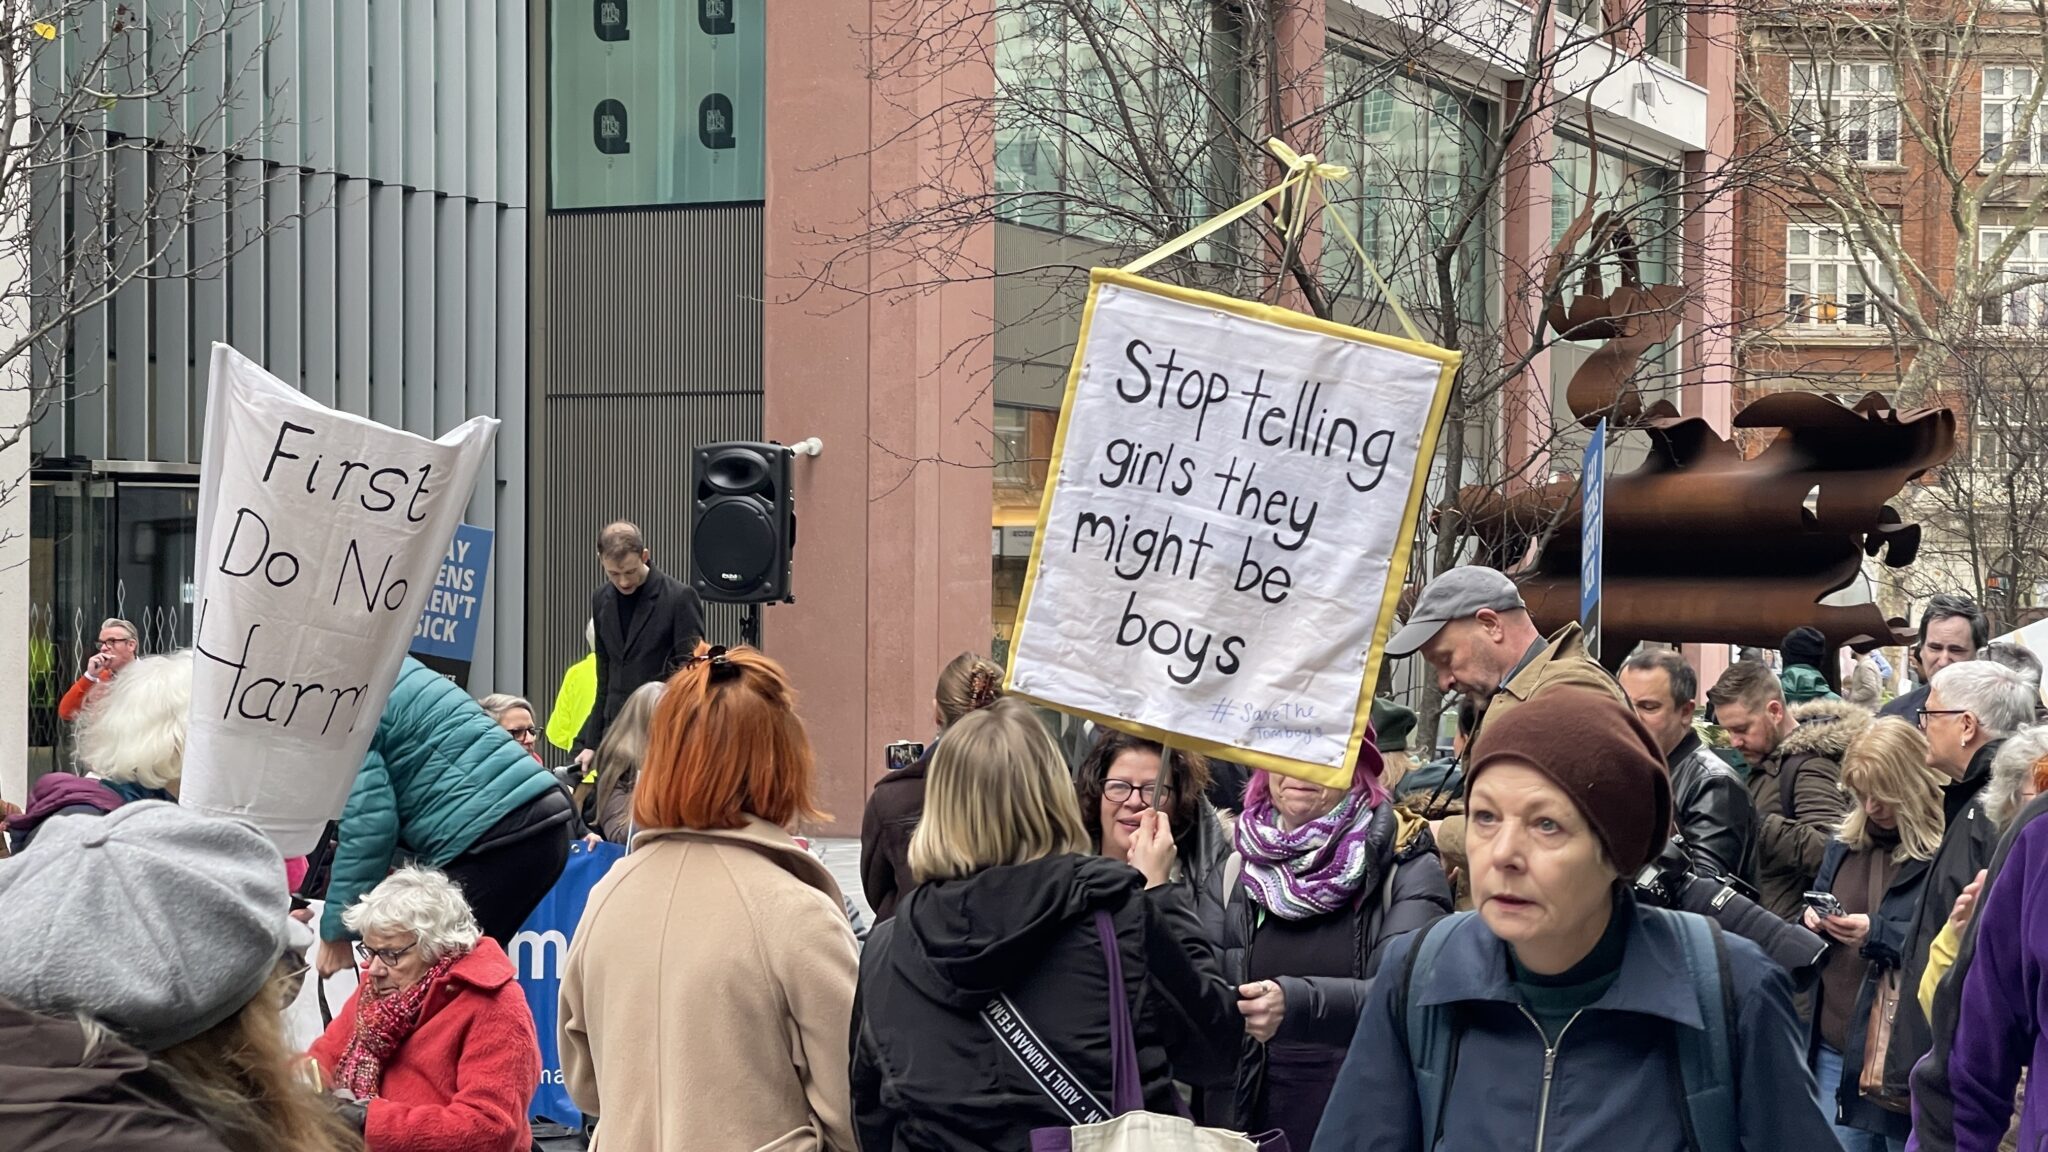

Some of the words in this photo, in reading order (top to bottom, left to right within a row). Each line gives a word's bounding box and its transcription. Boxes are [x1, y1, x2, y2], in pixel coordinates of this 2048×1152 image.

[1116, 339, 1230, 442] Stop
[1241, 369, 1396, 493] telling
[262, 421, 432, 523] First
[1099, 438, 1196, 497] girls
[1214, 456, 1318, 552] they
[219, 507, 300, 588] Do
[332, 539, 408, 613] No
[434, 564, 476, 592] ENS
[1072, 511, 1214, 580] might
[1233, 535, 1292, 604] be
[196, 598, 369, 736] Harm
[1115, 590, 1246, 685] boys
[1010, 1029, 1050, 1073] HUMAN
[1043, 1069, 1083, 1105] ADULT
